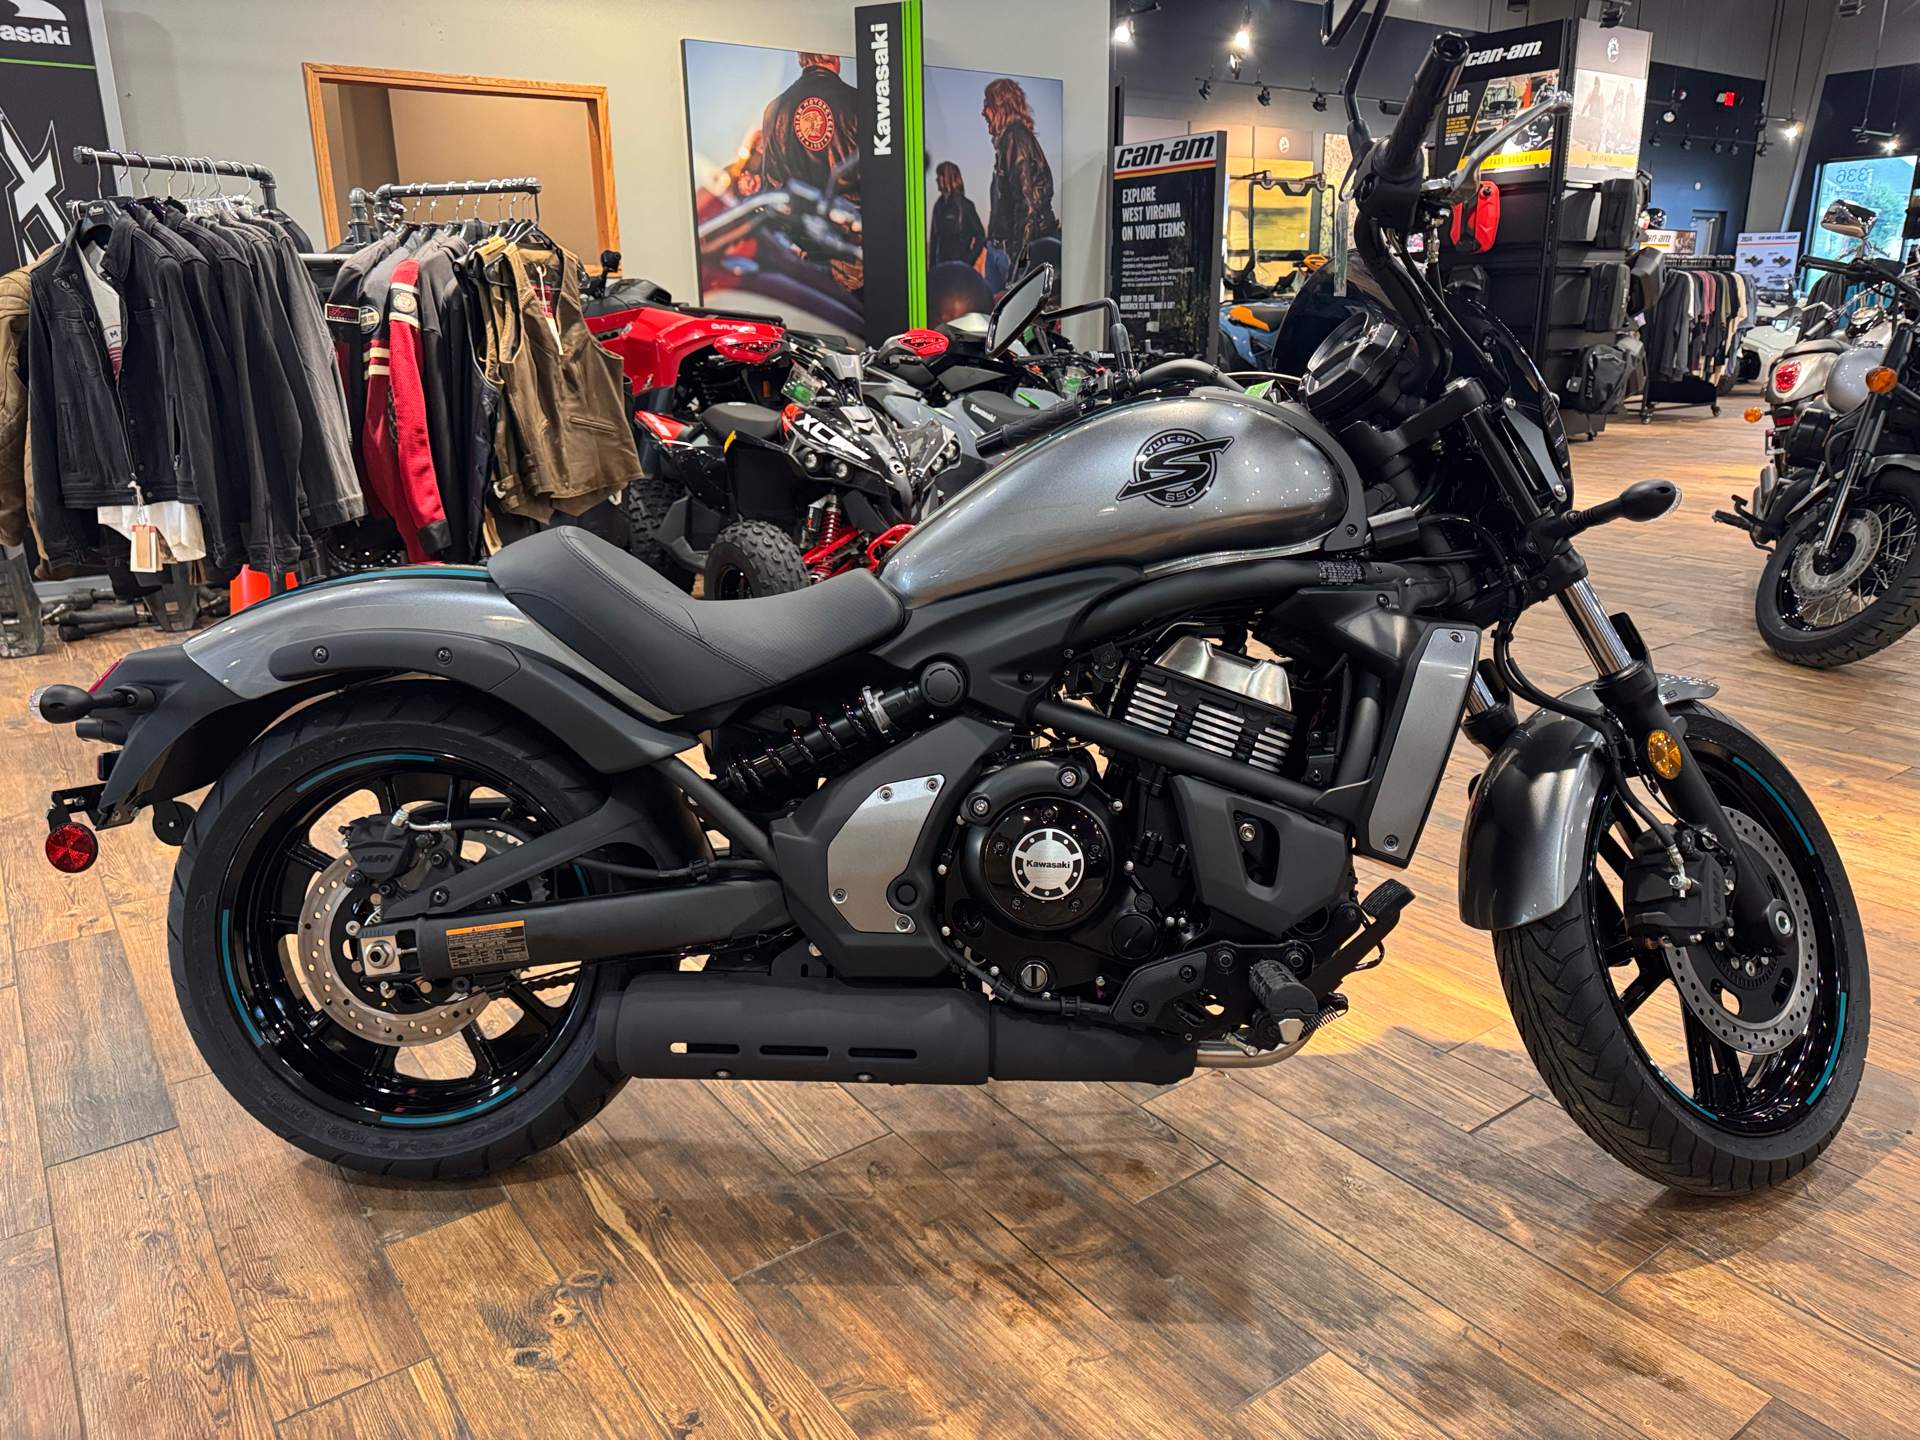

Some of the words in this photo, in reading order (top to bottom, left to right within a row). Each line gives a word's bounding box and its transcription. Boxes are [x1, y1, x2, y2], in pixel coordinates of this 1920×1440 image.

[1465, 40, 1541, 67] can-am
[870, 23, 892, 155] Kawasaki
[1447, 105, 1455, 115] IT
[1456, 103, 1468, 114] UP!
[1116, 136, 1214, 169] can-am
[1122, 186, 1156, 204] EXPLORE
[1122, 207, 1143, 222] WEST
[1145, 202, 1181, 220] VIRGINIA
[1121, 225, 1133, 241] ON
[1135, 223, 1156, 240] YOUR
[1158, 221, 1186, 238] TERMS
[1648, 234, 1671, 243] an-am
[1165, 487, 1197, 501] 650
[1026, 860, 1070, 869] Kawasaki
